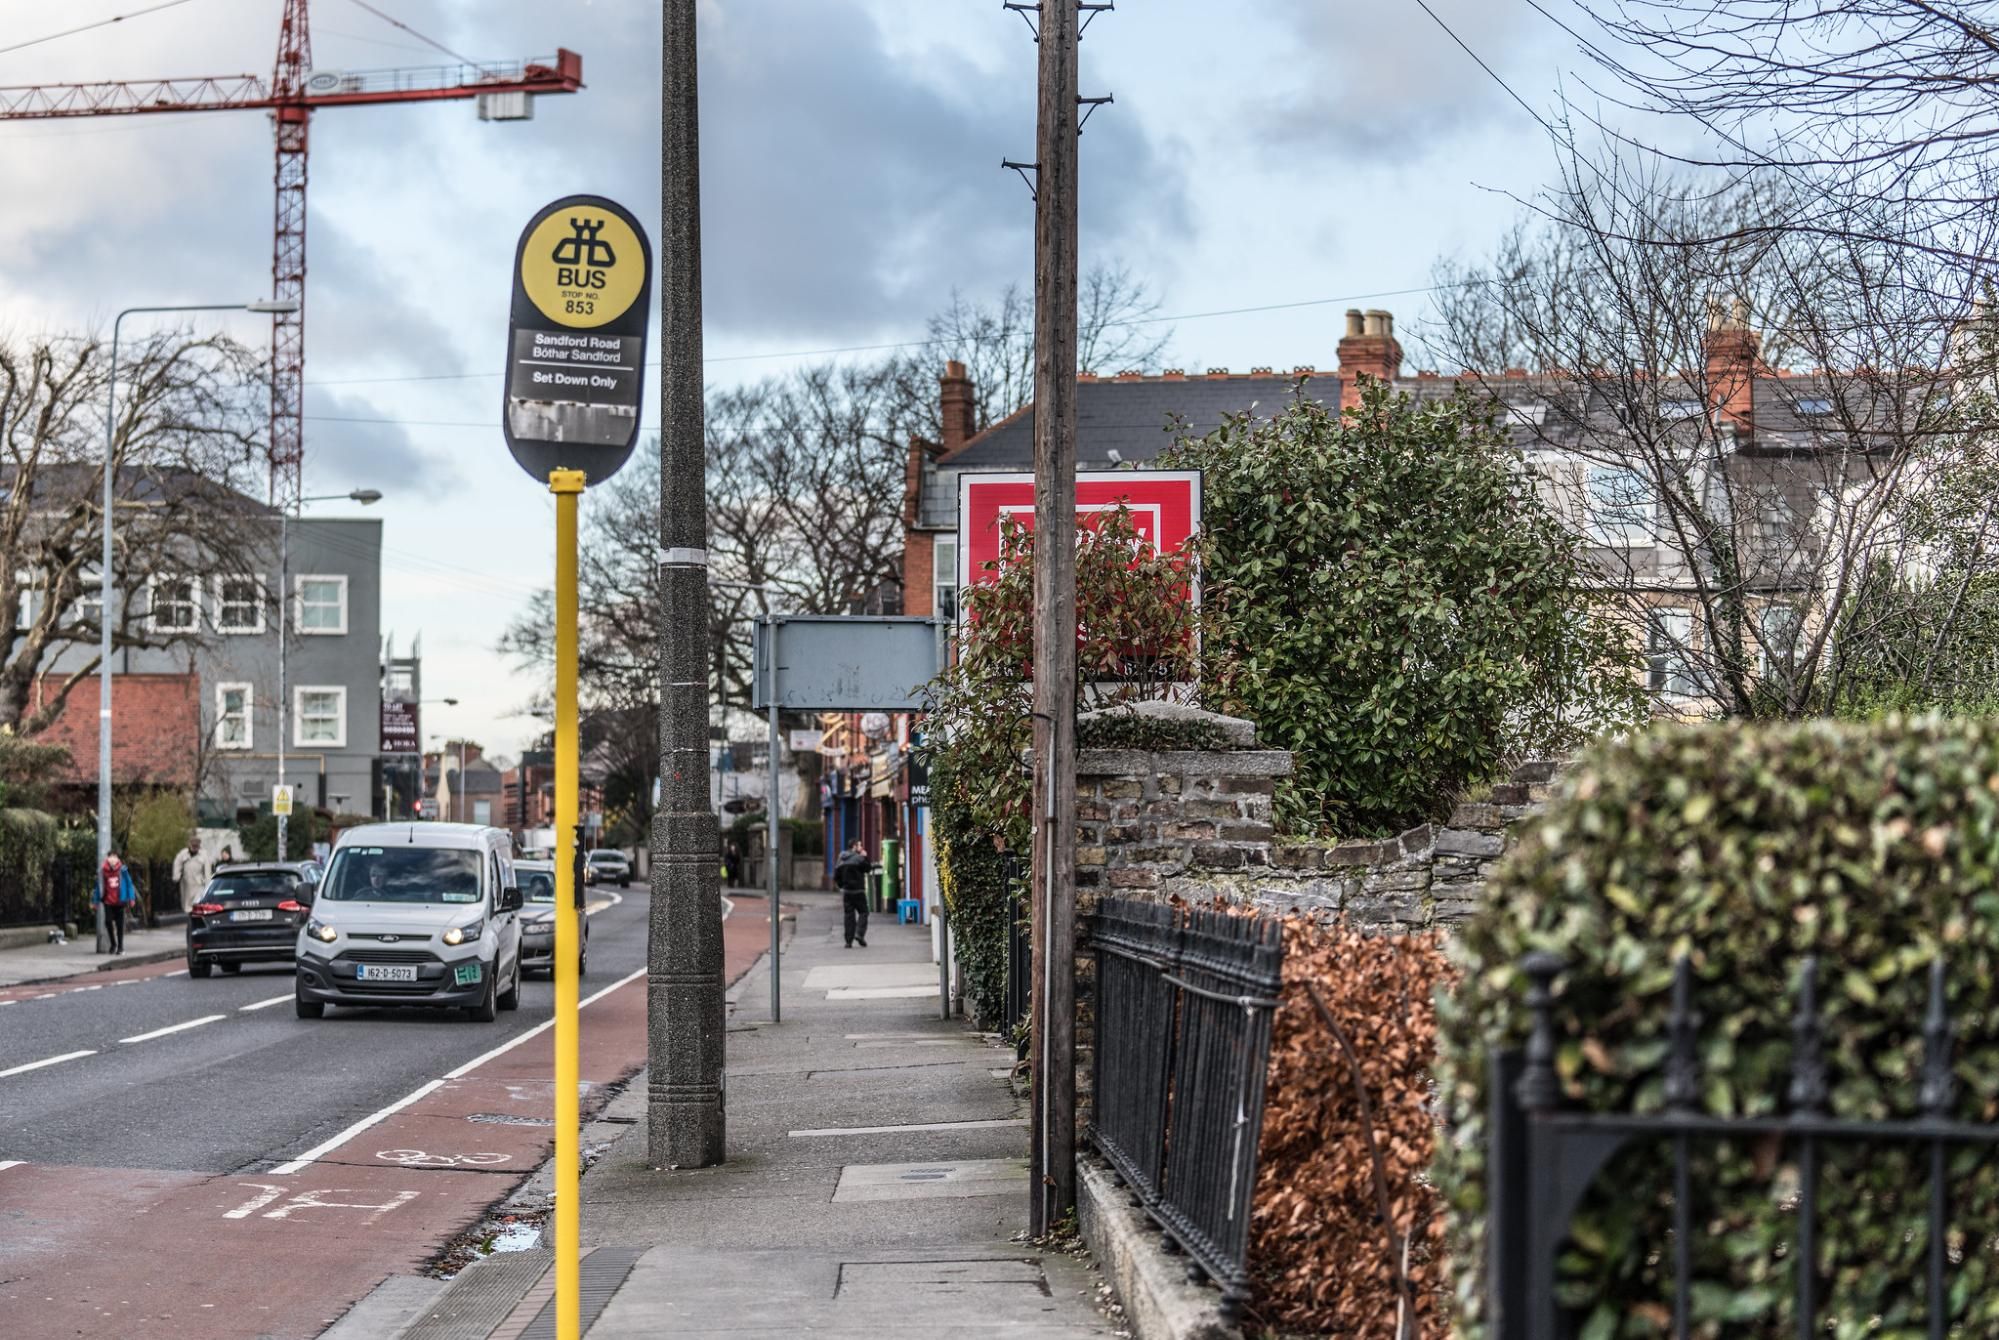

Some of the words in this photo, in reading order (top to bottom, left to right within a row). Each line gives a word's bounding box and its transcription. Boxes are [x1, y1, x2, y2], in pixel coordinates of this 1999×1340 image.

[557, 267, 606, 290] BUS
[561, 290, 584, 299] STOP
[565, 299, 594, 315] 853
[535, 333, 588, 348] Sandford
[590, 337, 621, 349] Road
[532, 346, 570, 360] Bóthar
[571, 349, 621, 363] Sandford
[532, 371, 553, 384] Set
[554, 373, 589, 386] Down
[590, 375, 617, 390] Only
[911, 785, 932, 795] MEA
[367, 967, 412, 979] 162-D-5073
